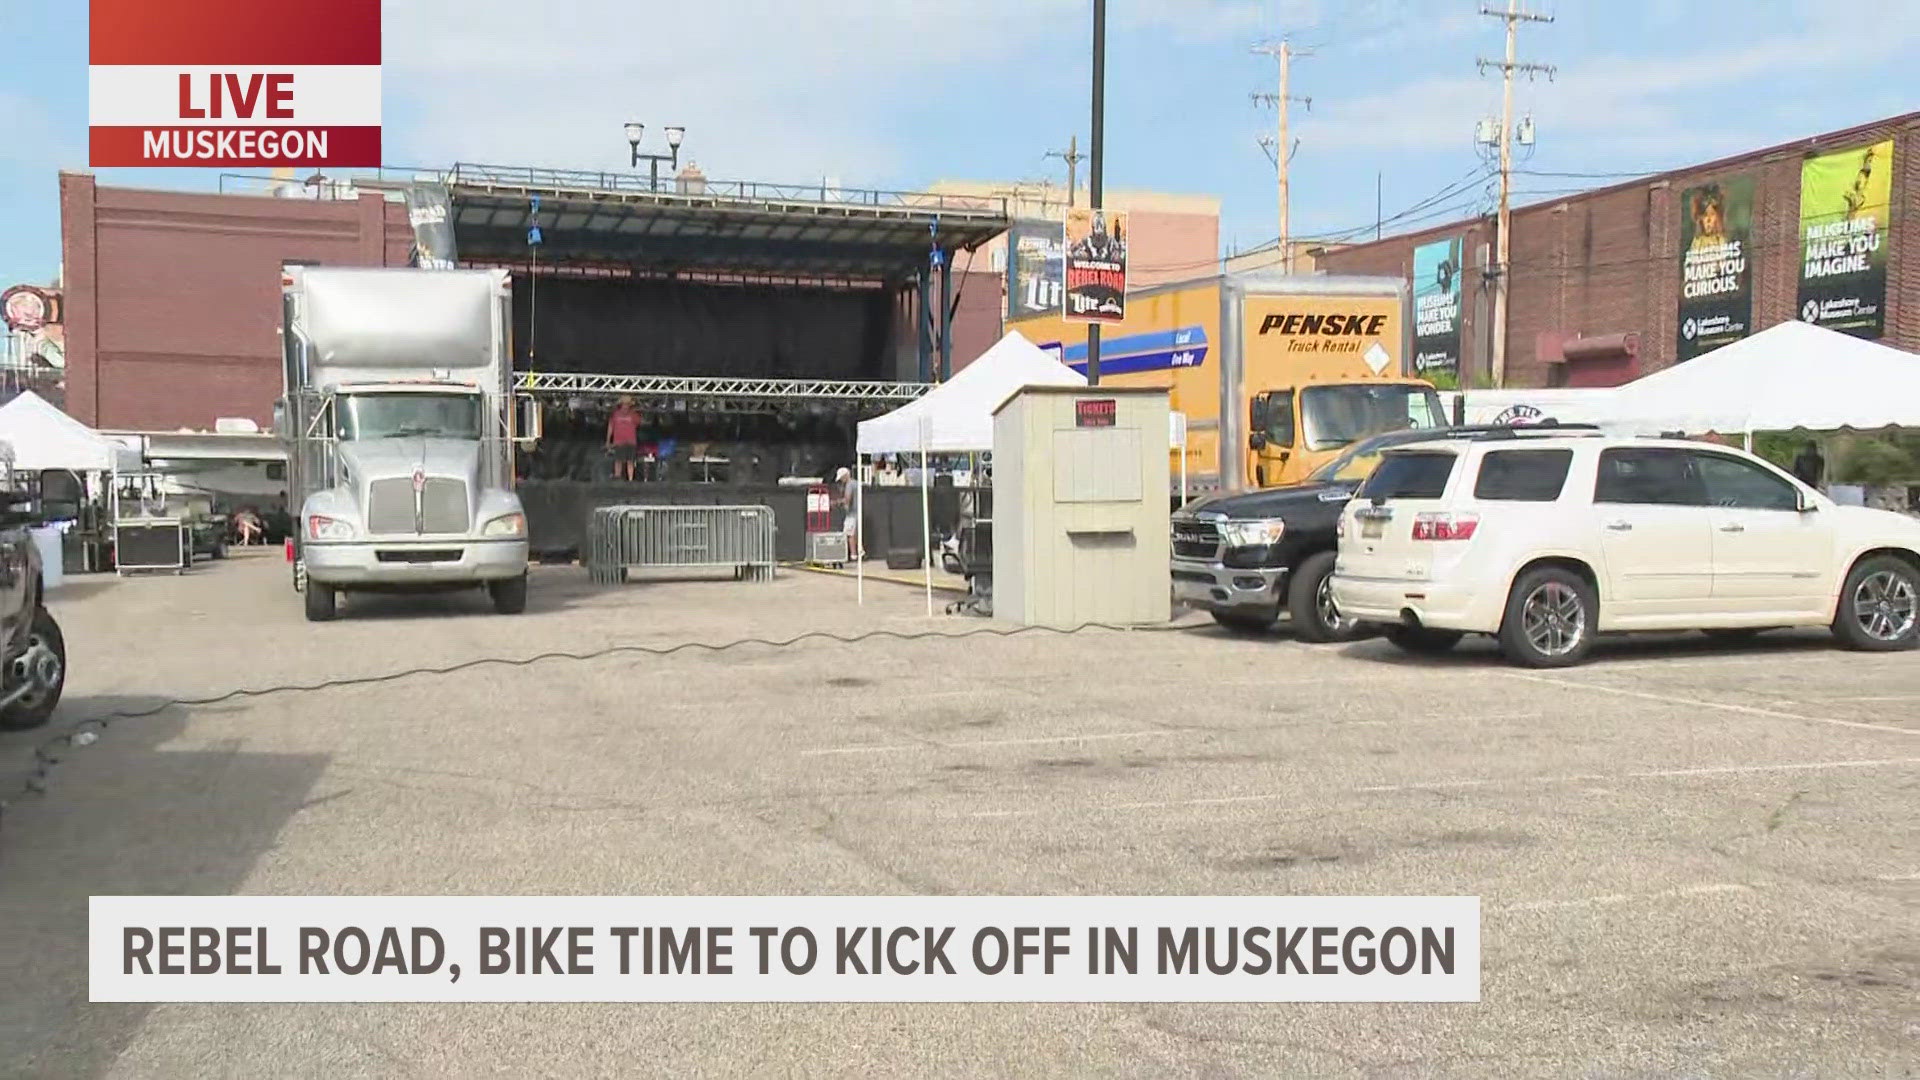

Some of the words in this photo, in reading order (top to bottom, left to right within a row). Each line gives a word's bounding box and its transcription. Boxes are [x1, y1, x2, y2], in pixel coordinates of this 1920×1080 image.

[1805, 216, 1876, 239] MUSEUMS
[1805, 239, 1846, 261] MAKE
[1848, 233, 1880, 254] YOU
[1073, 260, 1110, 272] WELCOME
[1109, 263, 1121, 272] TO
[1684, 262, 1718, 283] MAKE
[1718, 257, 1746, 276] YOU
[1804, 253, 1871, 279] IMAGINE.
[1068, 269, 1099, 290] REBEL
[1099, 271, 1125, 293] ROAD
[1683, 275, 1740, 299] CURIOUS.
[1258, 313, 1388, 336] PENSKE
[1416, 306, 1441, 323] MAKE
[1440, 304, 1458, 321] YOU
[1416, 319, 1454, 337] WONDER.
[1287, 339, 1320, 353] Truck
[1321, 339, 1362, 353] Rental
